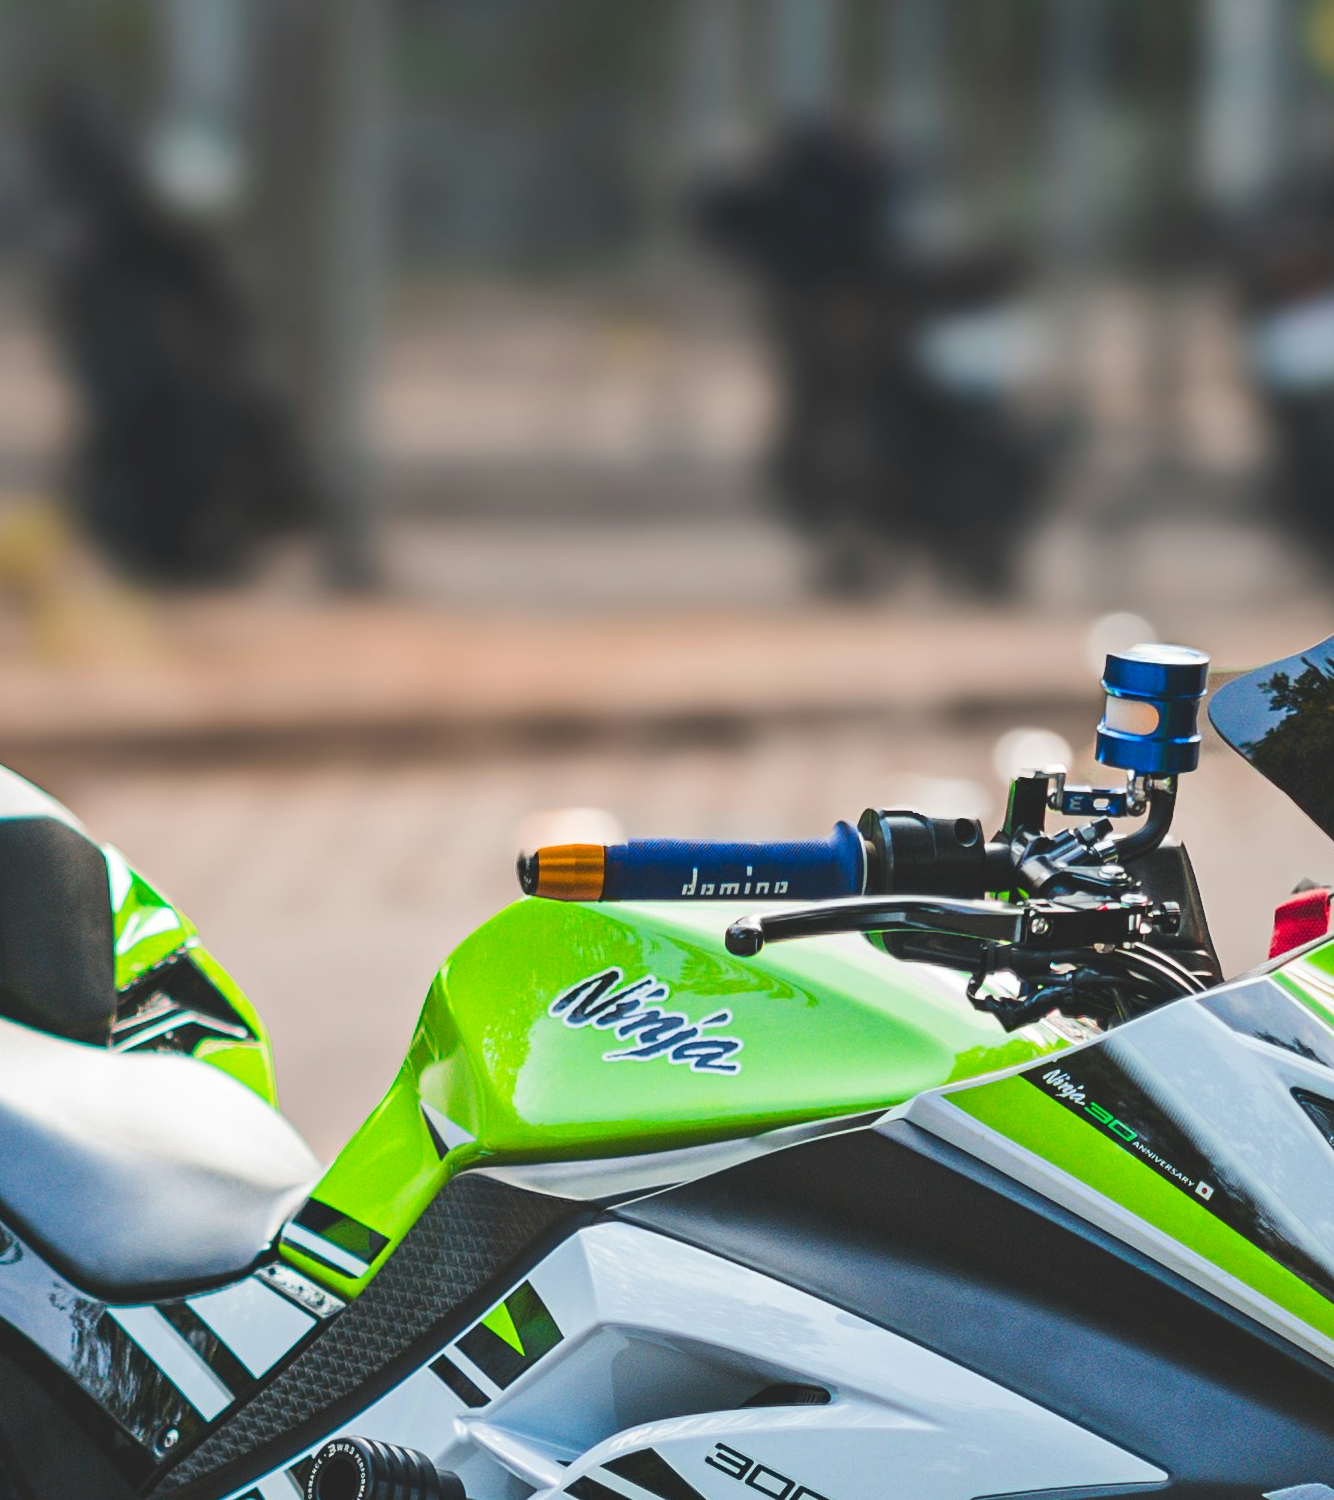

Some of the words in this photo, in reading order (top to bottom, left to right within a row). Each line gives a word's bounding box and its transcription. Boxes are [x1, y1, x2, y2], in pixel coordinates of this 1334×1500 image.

[681, 865, 789, 896] domino
[549, 968, 741, 1074] Ninja
[1042, 1068, 1086, 1106] Ninja
[1084, 1101, 1137, 1142] 30
[1132, 1140, 1195, 1187] ANNIVERSARY
